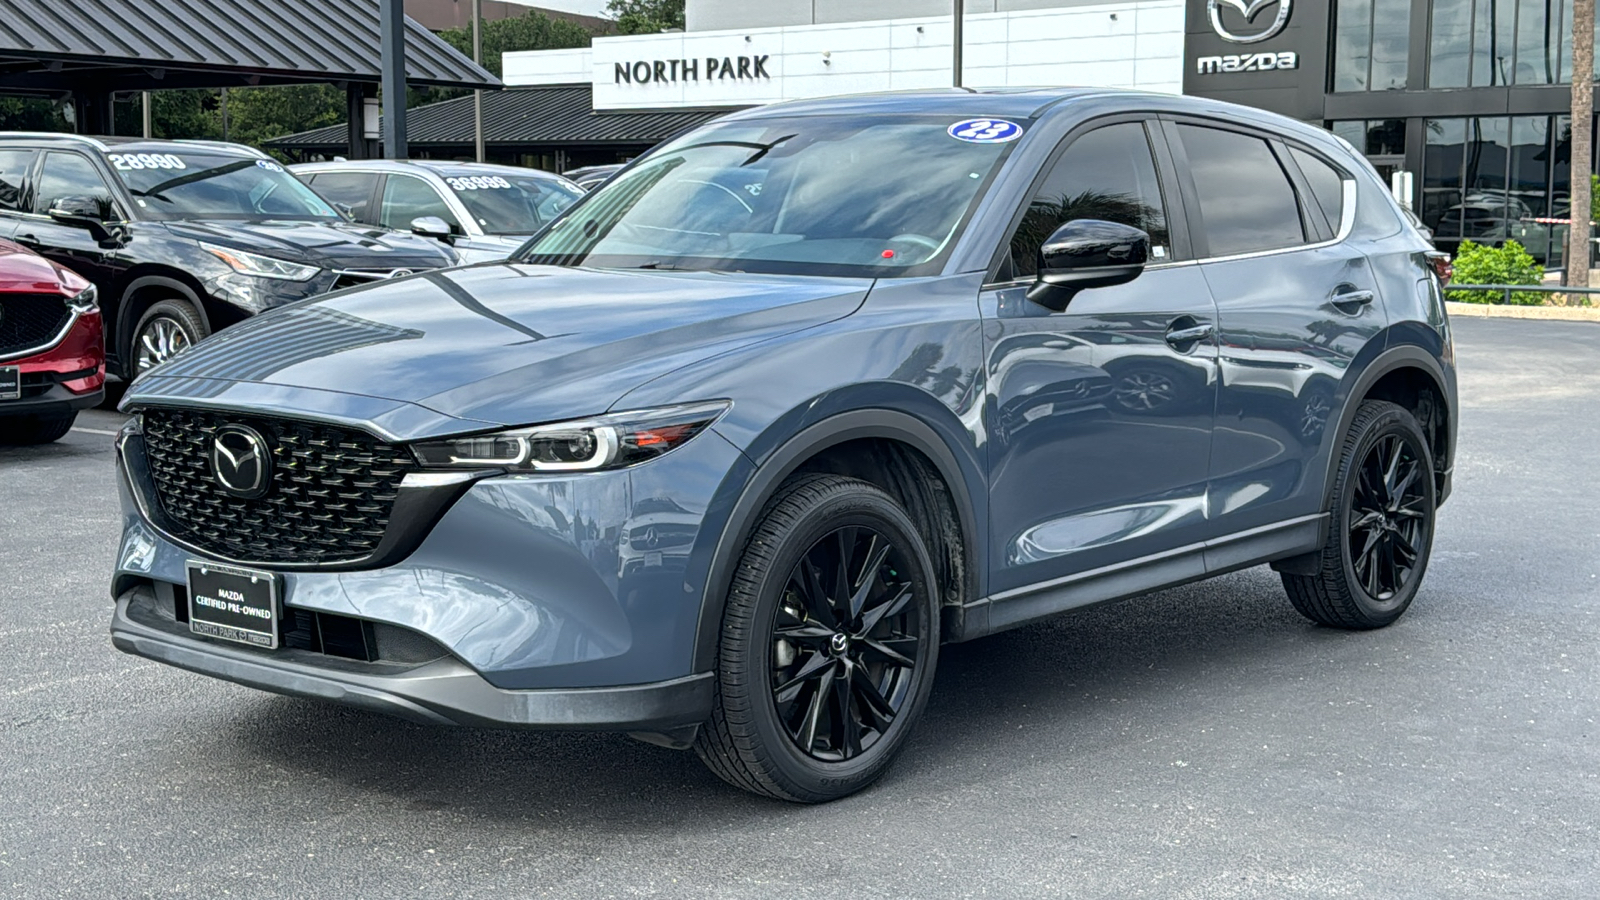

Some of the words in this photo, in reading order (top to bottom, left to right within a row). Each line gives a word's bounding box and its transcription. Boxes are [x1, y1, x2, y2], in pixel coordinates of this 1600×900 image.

[614, 58, 699, 84] NORTH
[706, 54, 770, 80] PARK
[1197, 51, 1298, 75] mazda
[956, 120, 1011, 140] 23
[107, 153, 187, 171] 28990
[446, 175, 512, 191] 36999
[218, 588, 245, 602] MAZDA
[196, 595, 227, 610] CERTIFIED
[227, 602, 271, 619] PRE-OWNED
[194, 622, 218, 635] NORTH
[219, 627, 239, 640] PARK
